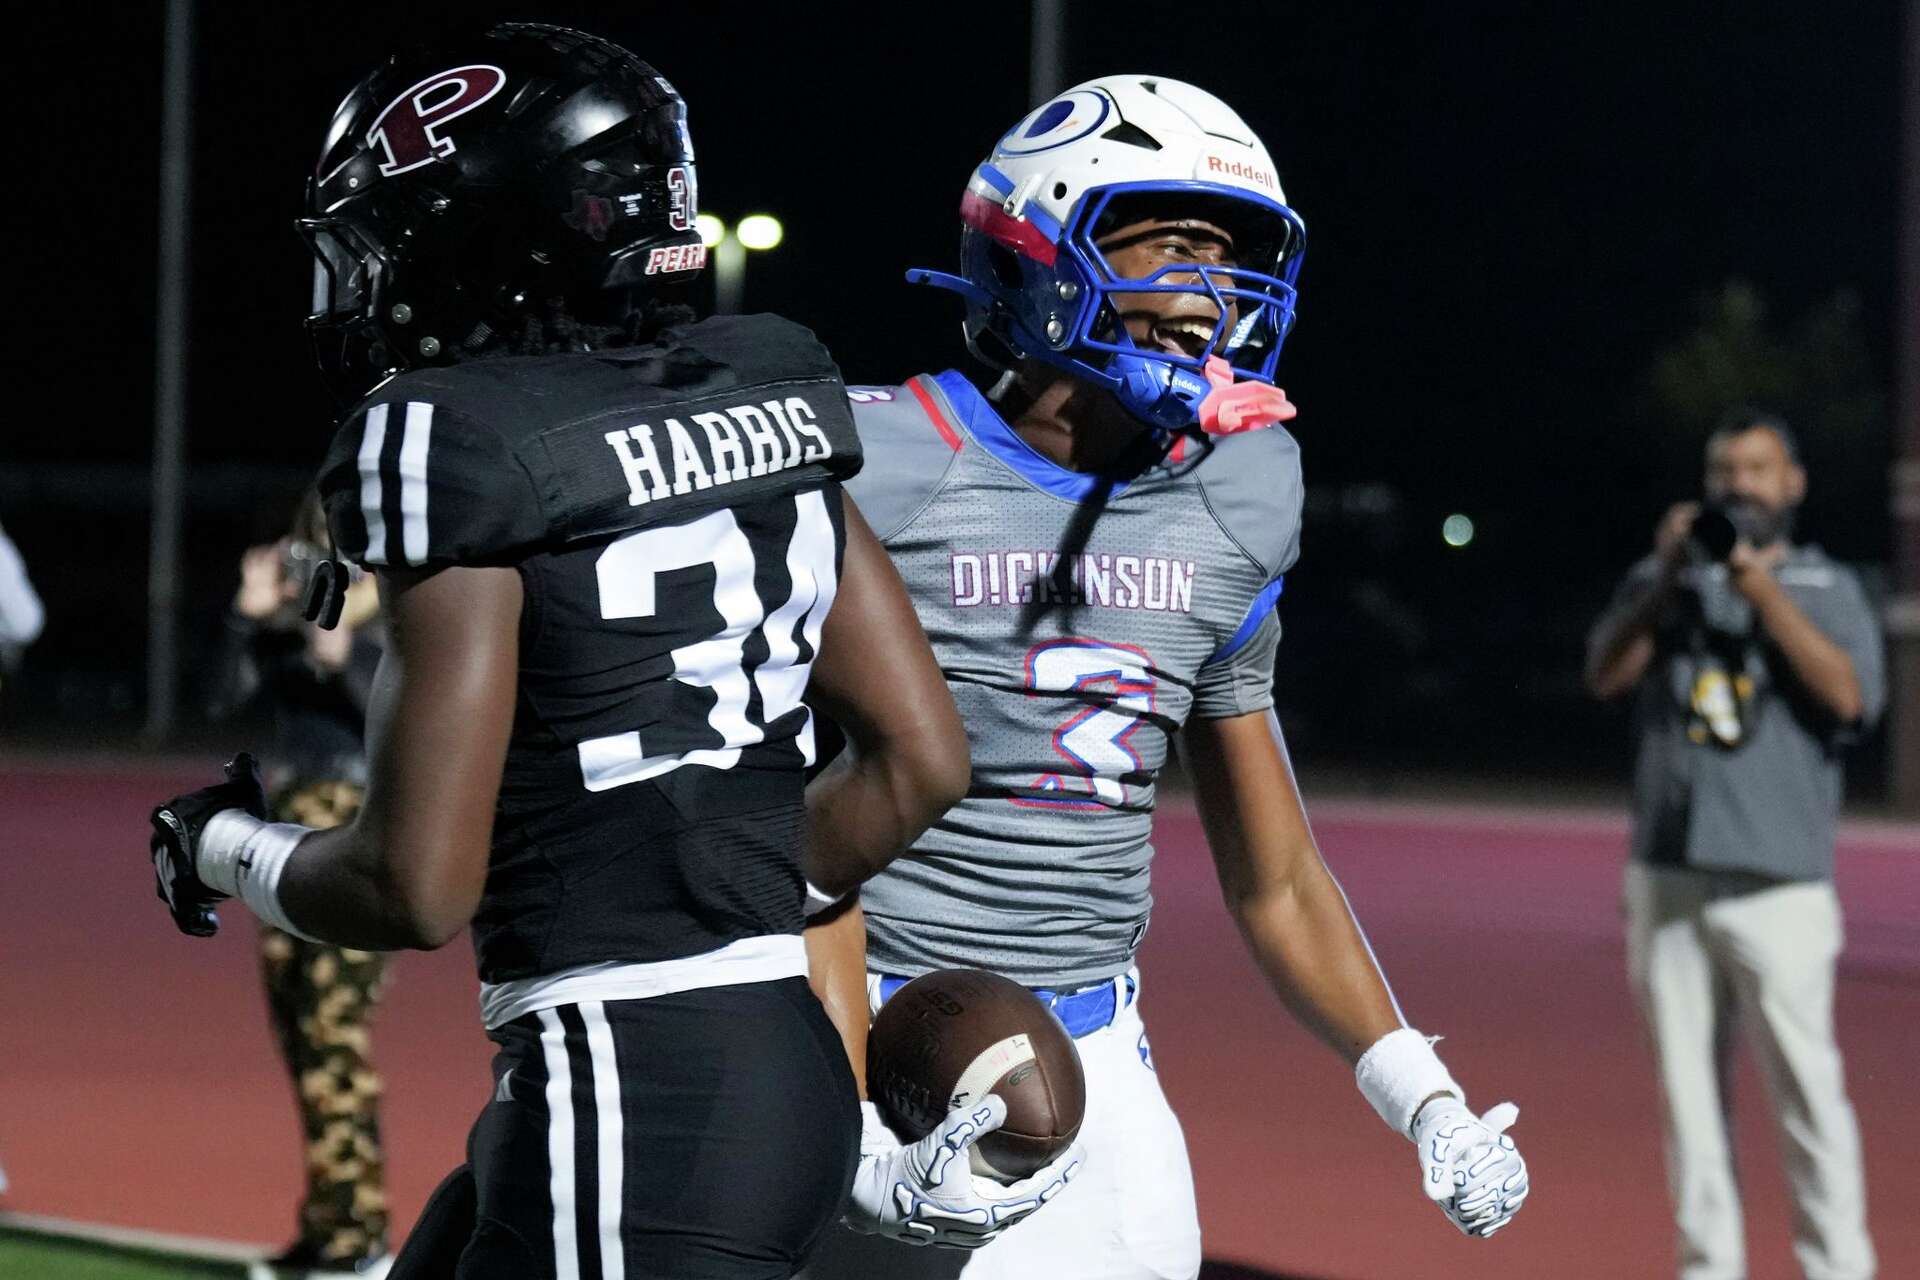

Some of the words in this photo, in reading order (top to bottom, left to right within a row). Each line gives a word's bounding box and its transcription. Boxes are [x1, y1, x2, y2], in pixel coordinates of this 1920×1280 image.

[366, 64, 506, 177] P
[1207, 155, 1274, 189] Riddell
[666, 167, 698, 231] 3
[604, 397, 832, 507] HARRIS
[577, 490, 838, 793] 34
